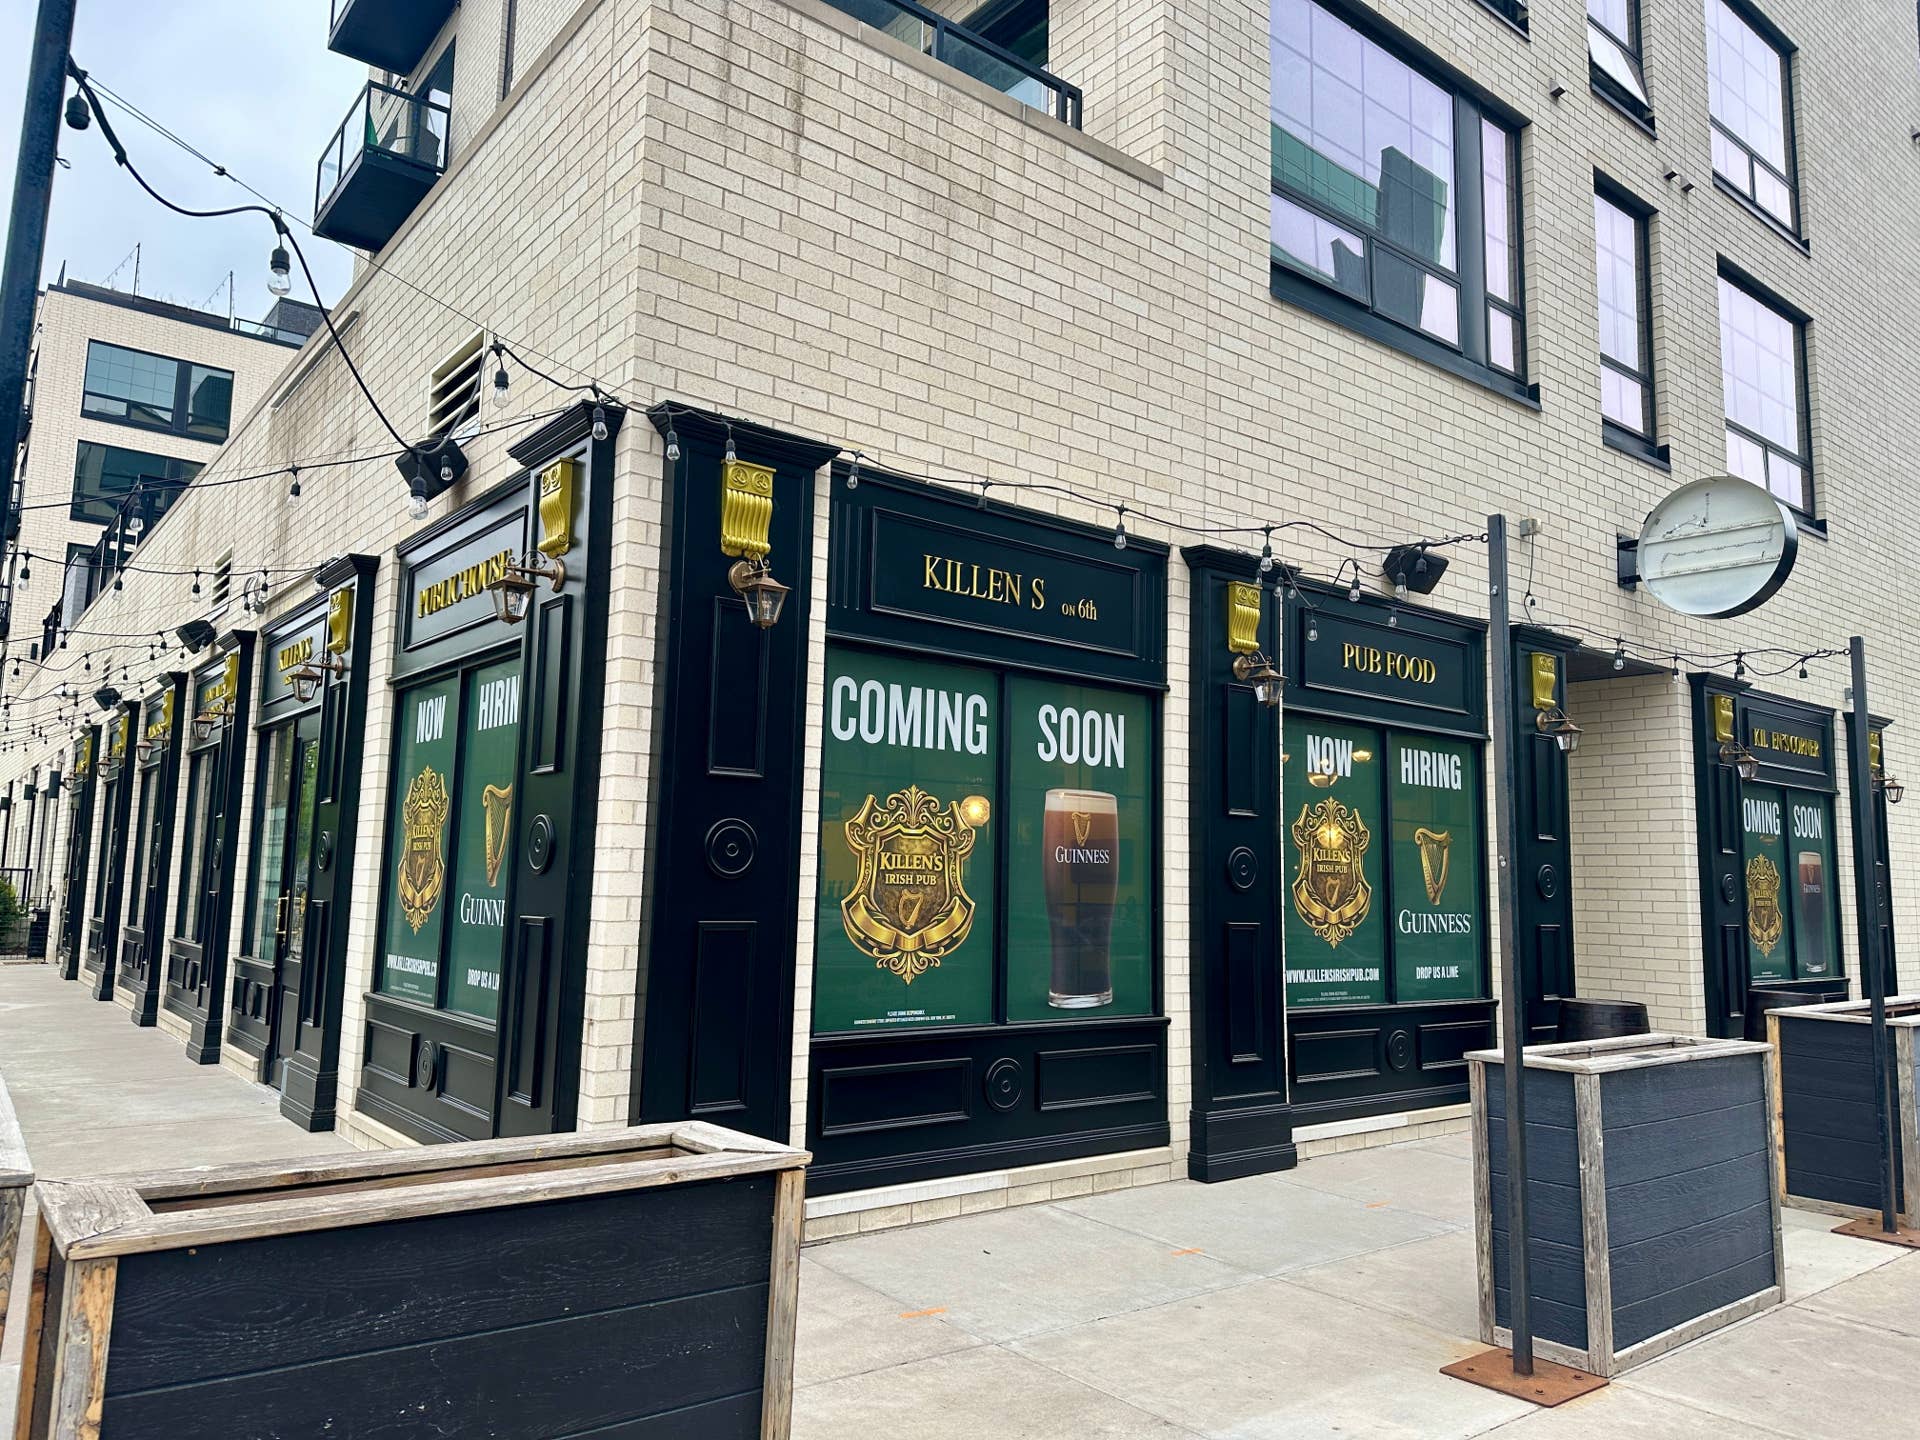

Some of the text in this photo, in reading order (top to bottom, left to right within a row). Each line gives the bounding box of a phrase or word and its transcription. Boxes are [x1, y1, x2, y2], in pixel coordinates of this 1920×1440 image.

[922, 554, 1022, 606] KILLEN
[1062, 603, 1076, 616] ON
[1078, 598, 1097, 620] 6th
[1342, 642, 1436, 684] PUB FOOD
[416, 675, 520, 744] NOW HIRIN
[831, 676, 1124, 769] COMING SOON
[1306, 734, 1462, 790] NOW HIRING
[1743, 798, 1822, 839] OMING SOON
[880, 852, 943, 871] KILLEN'S
[1055, 846, 1110, 864] GUINNESS
[1313, 848, 1350, 863] KILLEN'S
[1317, 864, 1347, 874] IRISH PUB
[885, 873, 937, 885] IRISH PUB
[461, 893, 505, 927] GUINN
[1398, 909, 1471, 934] GUINNESS
[1416, 966, 1459, 979] DROP US A LINE
